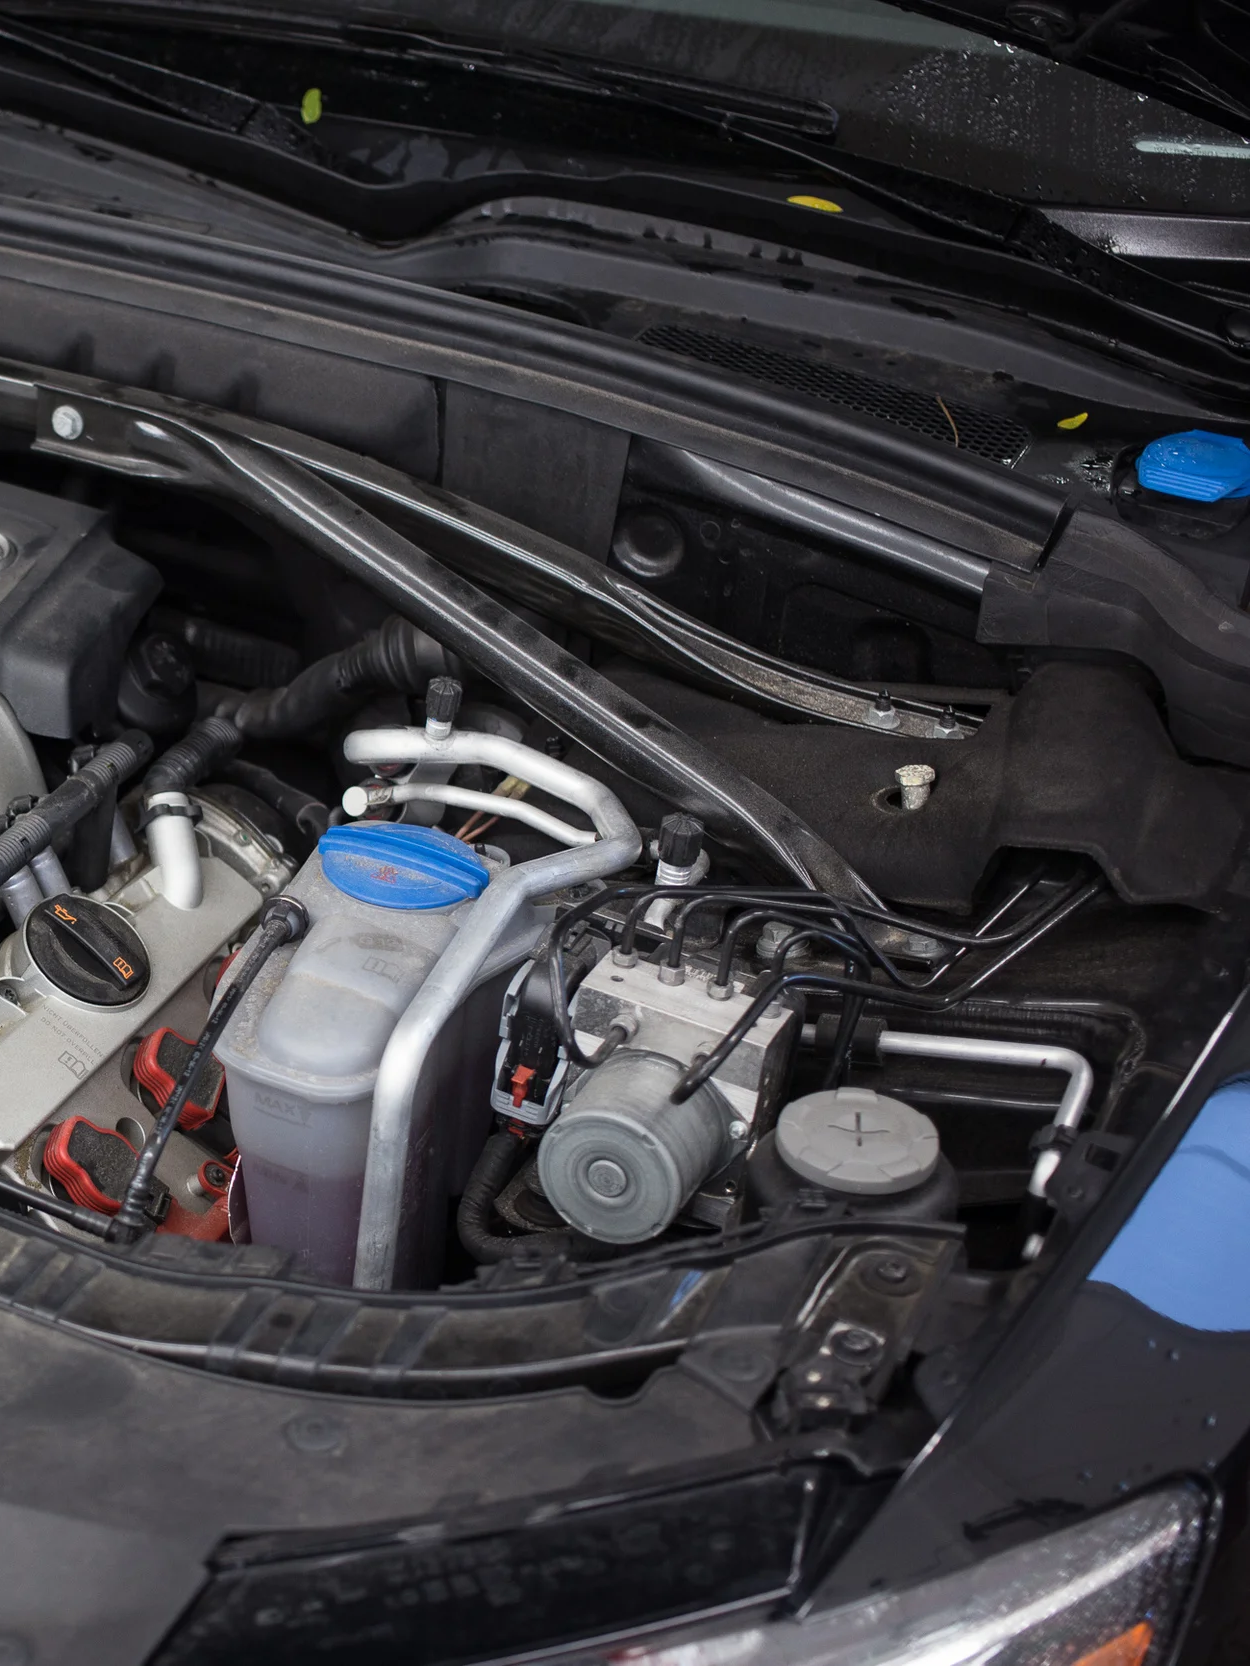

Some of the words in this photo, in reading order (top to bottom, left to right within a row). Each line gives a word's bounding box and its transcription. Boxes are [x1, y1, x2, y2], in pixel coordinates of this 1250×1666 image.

[41, 1004, 63, 1021] NICHT
[40, 1016, 51, 1026] DO
[52, 1025, 66, 1037] NOT
[66, 1037, 96, 1066] OVERFILL
[254, 1091, 296, 1117] MAX
